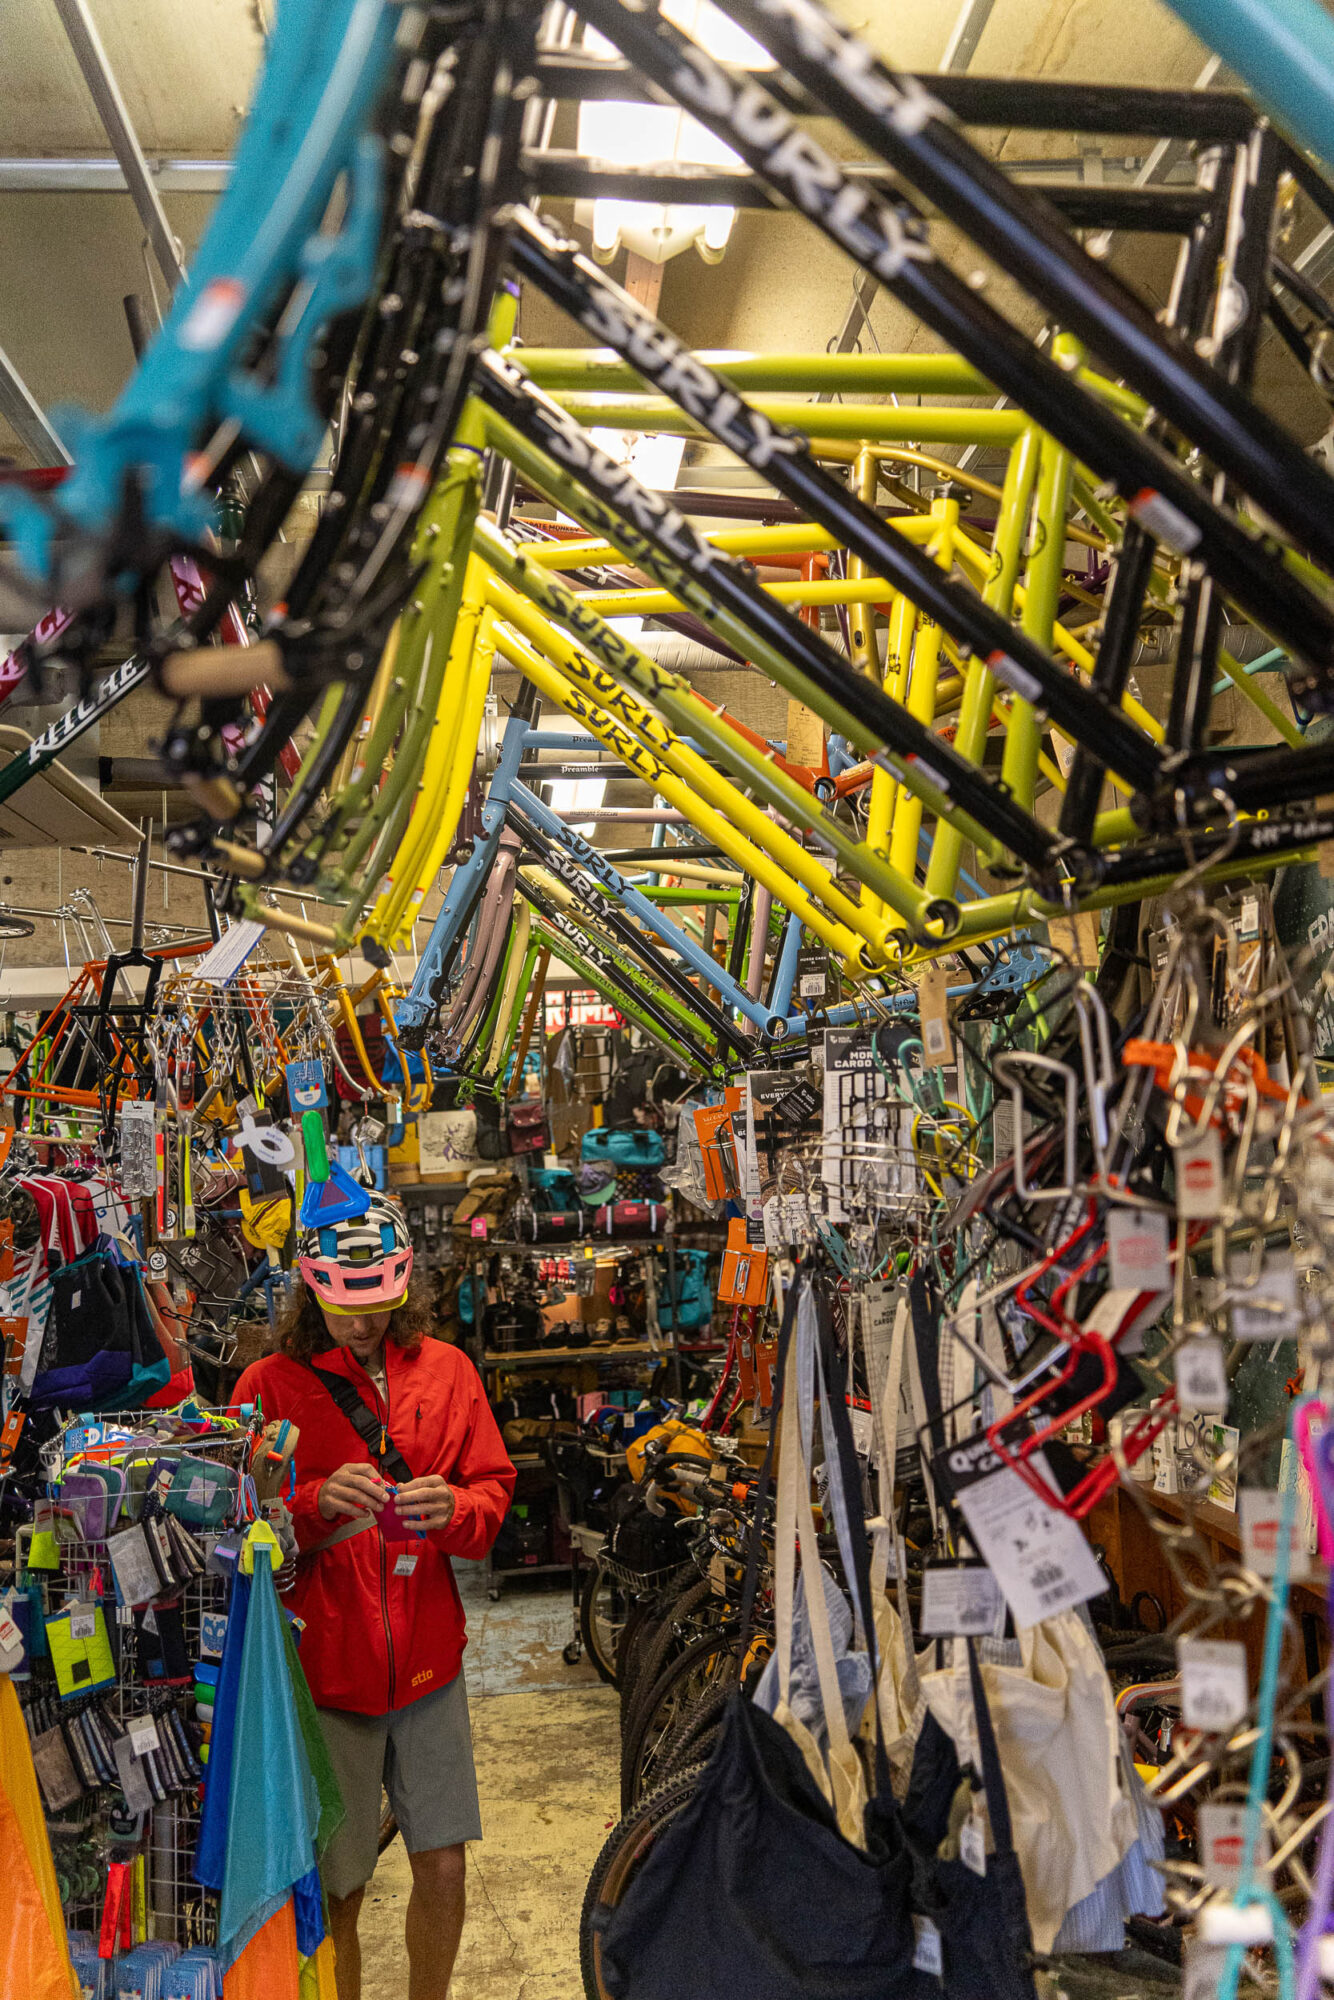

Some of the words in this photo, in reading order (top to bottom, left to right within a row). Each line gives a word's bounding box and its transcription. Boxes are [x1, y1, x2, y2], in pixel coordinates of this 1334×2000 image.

[675, 44, 935, 279] SURLY
[581, 287, 799, 467] SURLY
[534, 408, 732, 571] SURLY
[540, 584, 677, 698] SURLY
[28, 653, 138, 766] RITCHE
[562, 689, 674, 782] SURLY
[564, 651, 685, 751] SURLY
[572, 735, 600, 744] Pream
[561, 765, 600, 774] Preamble
[544, 849, 618, 917] SURLY
[555, 826, 634, 896] SURLY
[551, 911, 611, 966] SURLY
[834, 1059, 872, 1068] CARGO
[411, 1669, 434, 1688] stio
